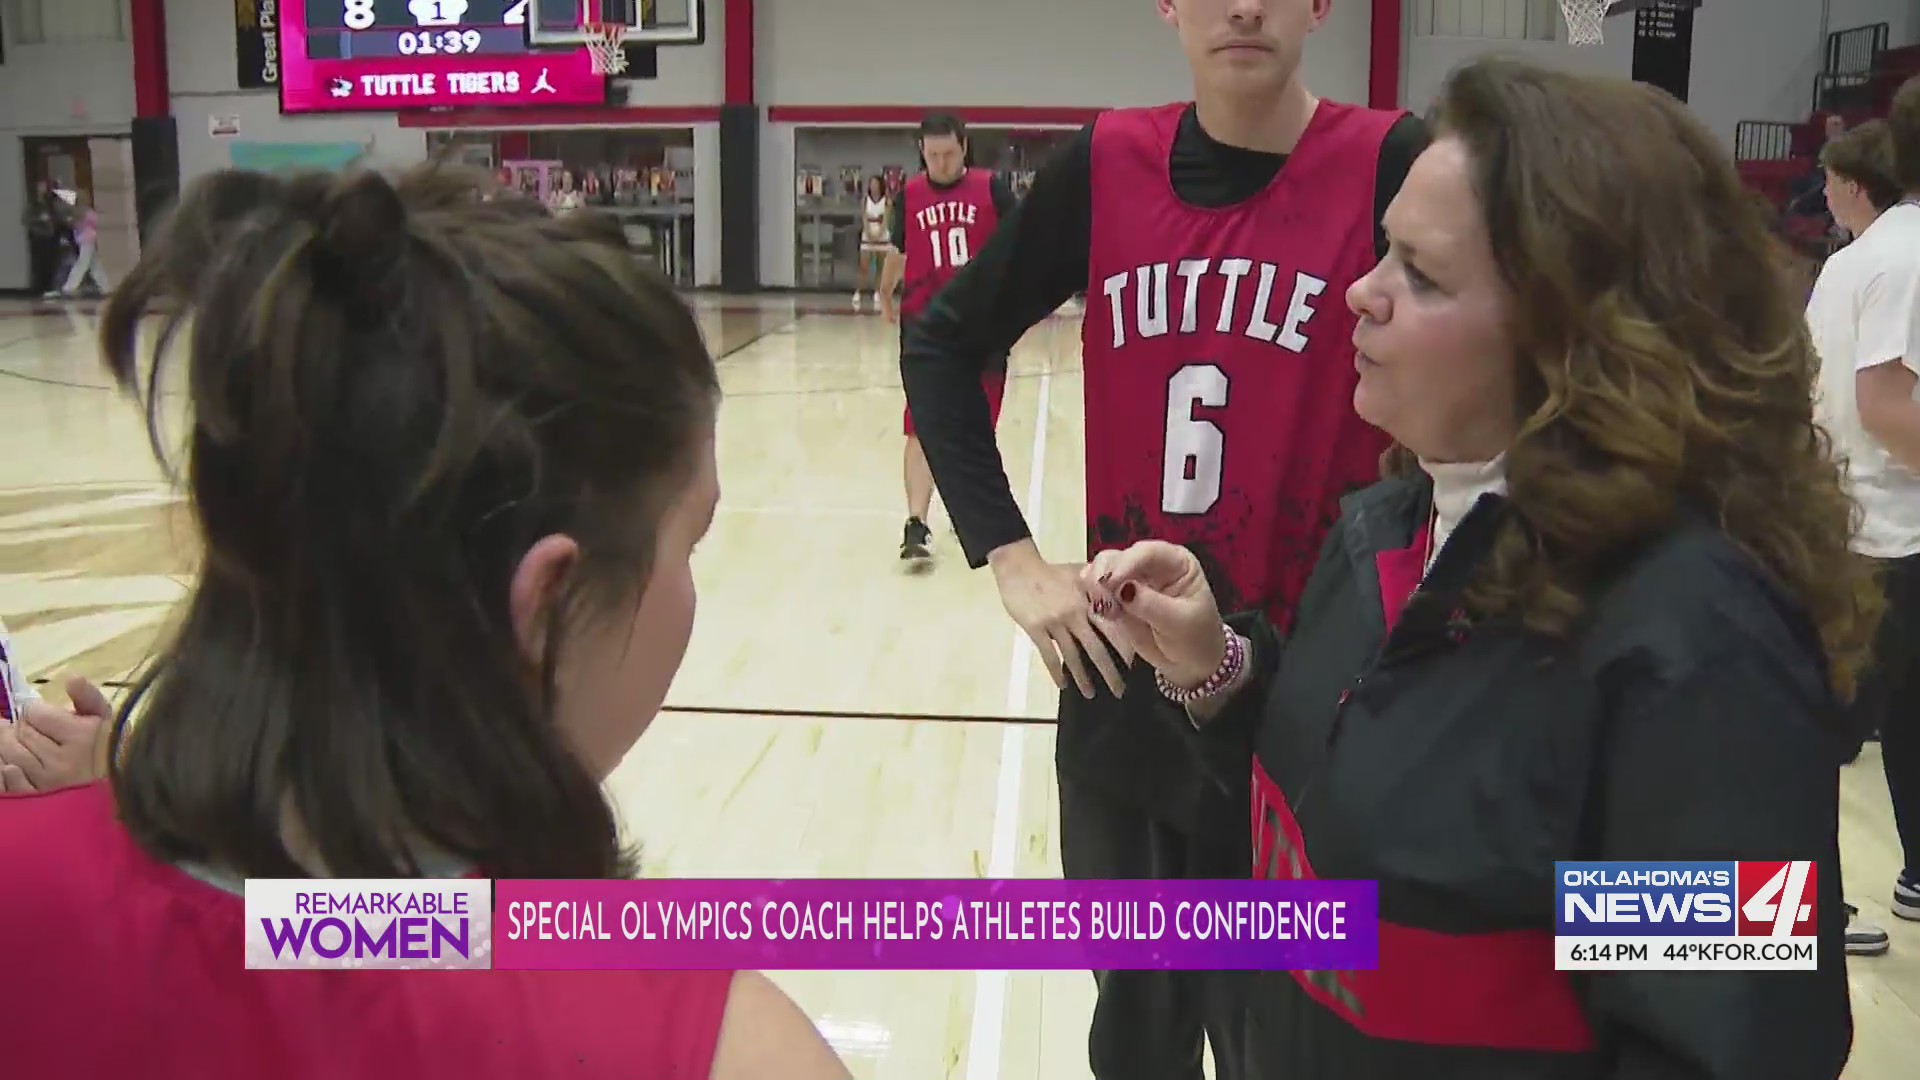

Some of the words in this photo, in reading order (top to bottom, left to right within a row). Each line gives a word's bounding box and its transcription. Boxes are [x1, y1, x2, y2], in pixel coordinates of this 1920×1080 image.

[343, 0, 376, 30] 8
[431, 1, 447, 21] 1
[262, 31, 278, 82] Great
[398, 29, 481, 55] 01:39
[360, 73, 437, 97] TUTTLE
[446, 71, 520, 95] TIGERS
[915, 201, 978, 231] TUTTLE
[929, 226, 970, 268] 10
[1103, 258, 1328, 353] TUTTLE
[1161, 364, 1229, 513] 6
